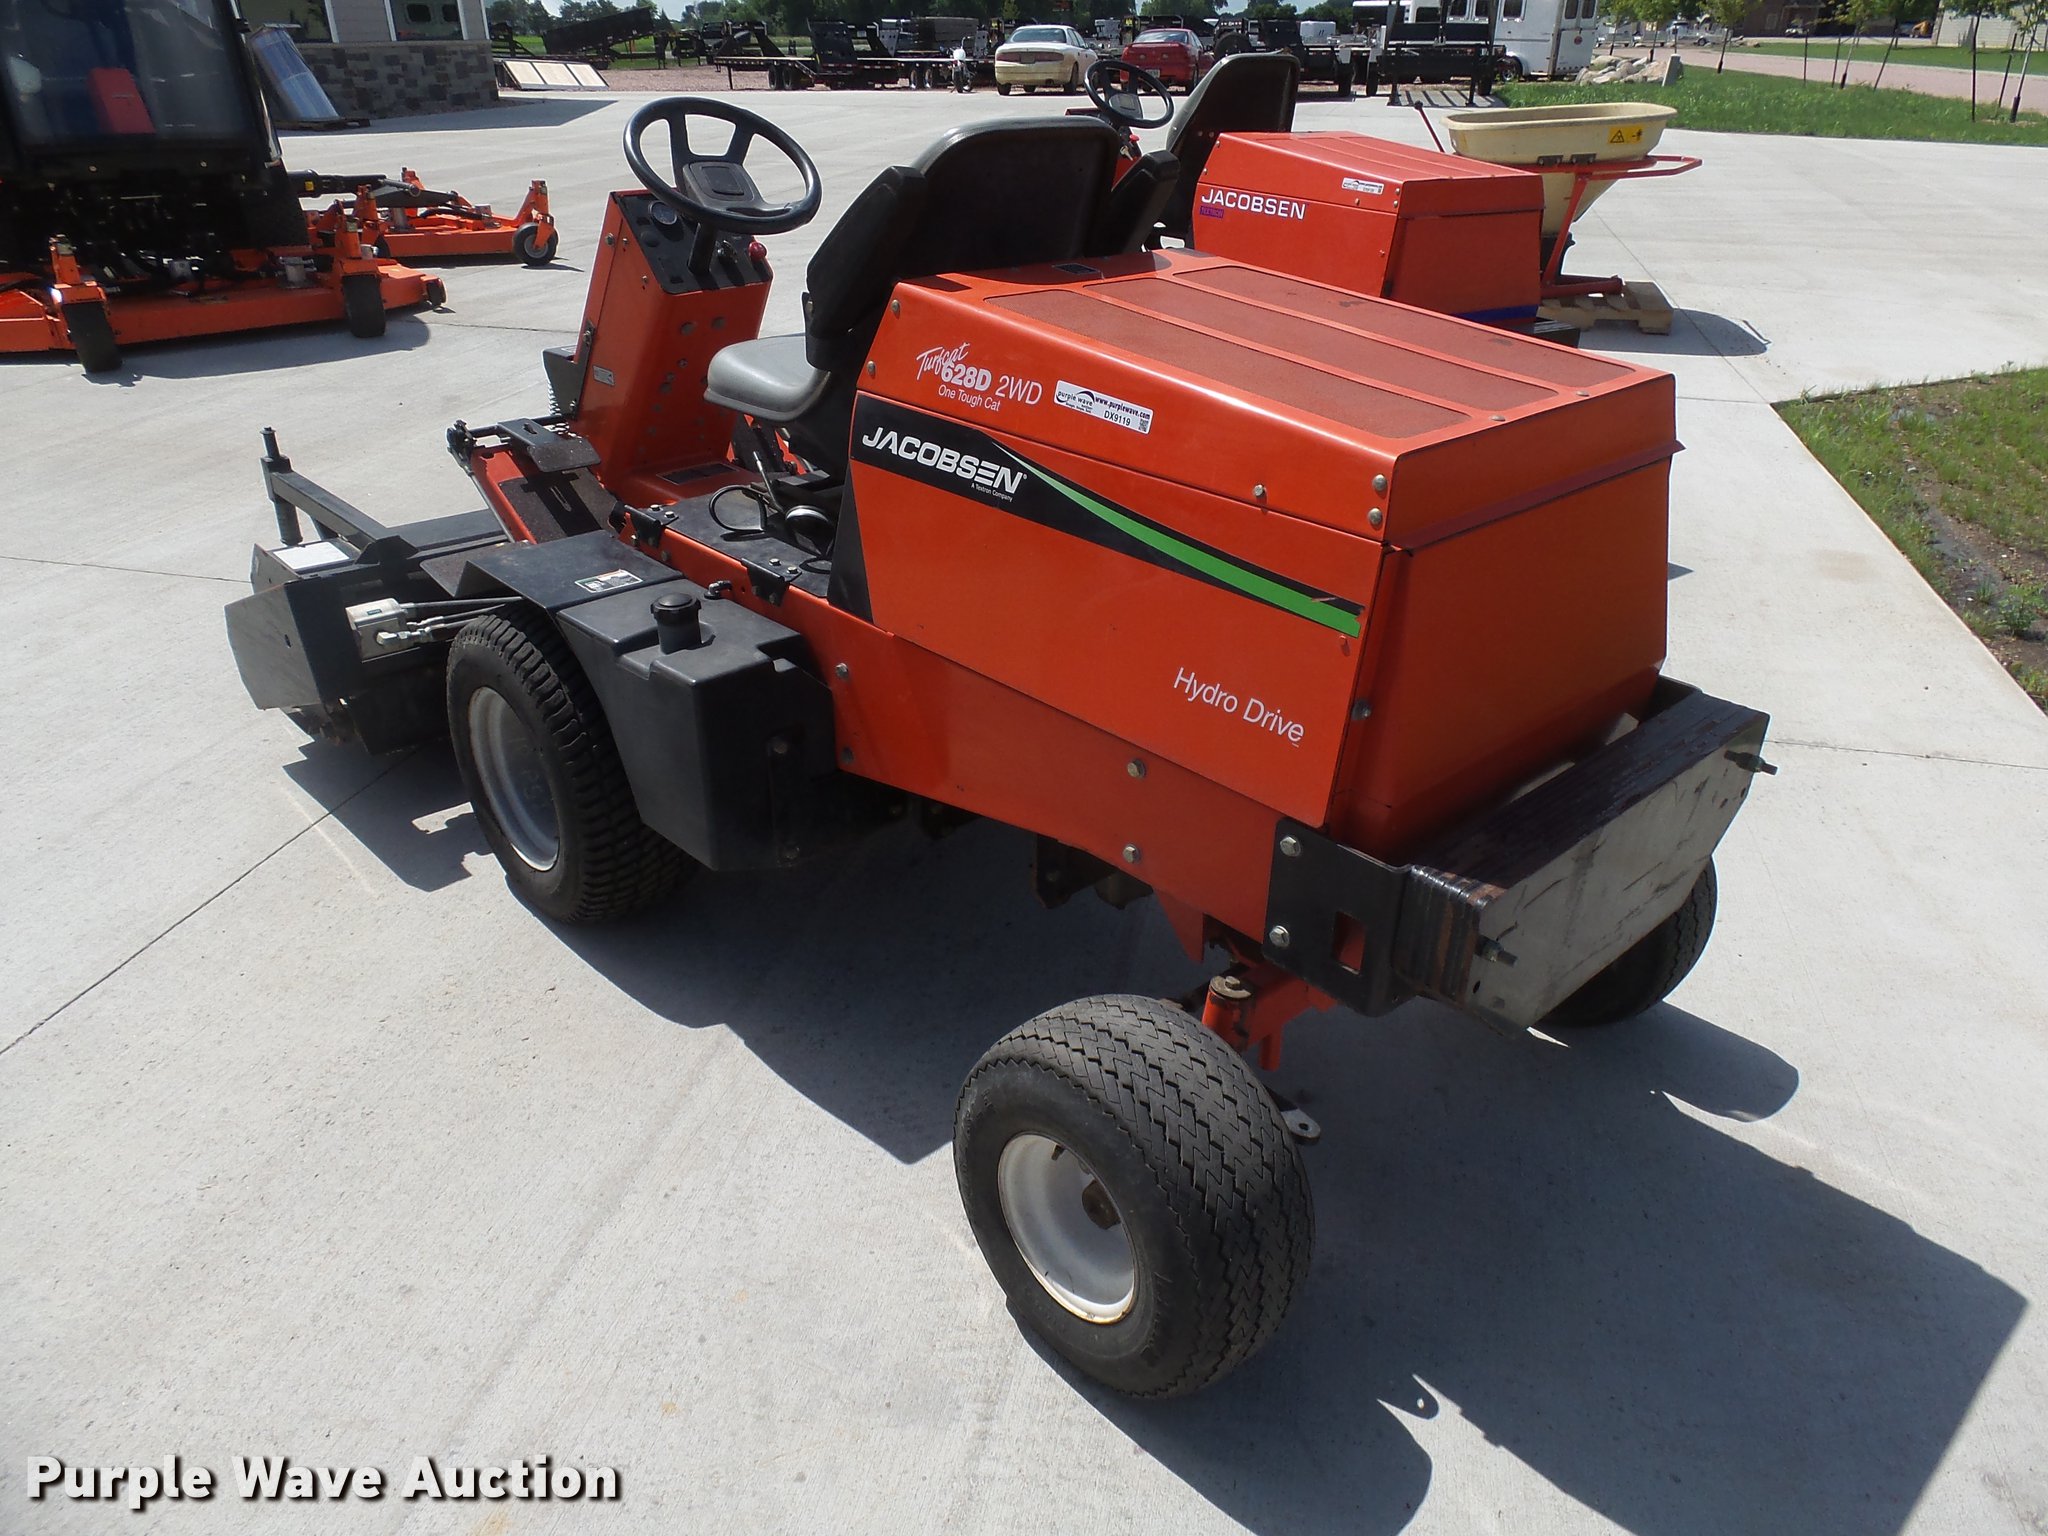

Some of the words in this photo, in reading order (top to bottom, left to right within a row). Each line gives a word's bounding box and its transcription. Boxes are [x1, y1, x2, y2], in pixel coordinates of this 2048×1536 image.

[1201, 188, 1306, 220] JACOBSEN
[941, 362, 992, 391] 628D
[995, 375, 1042, 404] 2WD
[938, 384, 956, 399] One
[958, 388, 983, 408] Tough
[984, 397, 1001, 412] Cat
[1057, 390, 1077, 402] purple
[1077, 396, 1093, 407] wave
[1095, 395, 1151, 420] www.purplewave.com
[1104, 410, 1131, 427] DX9119
[862, 427, 1024, 495] JACOBSEN
[975, 483, 992, 495] Textron
[992, 489, 1013, 503] Company
[1173, 667, 1239, 713] Hydro
[1243, 697, 1305, 742] Drive
